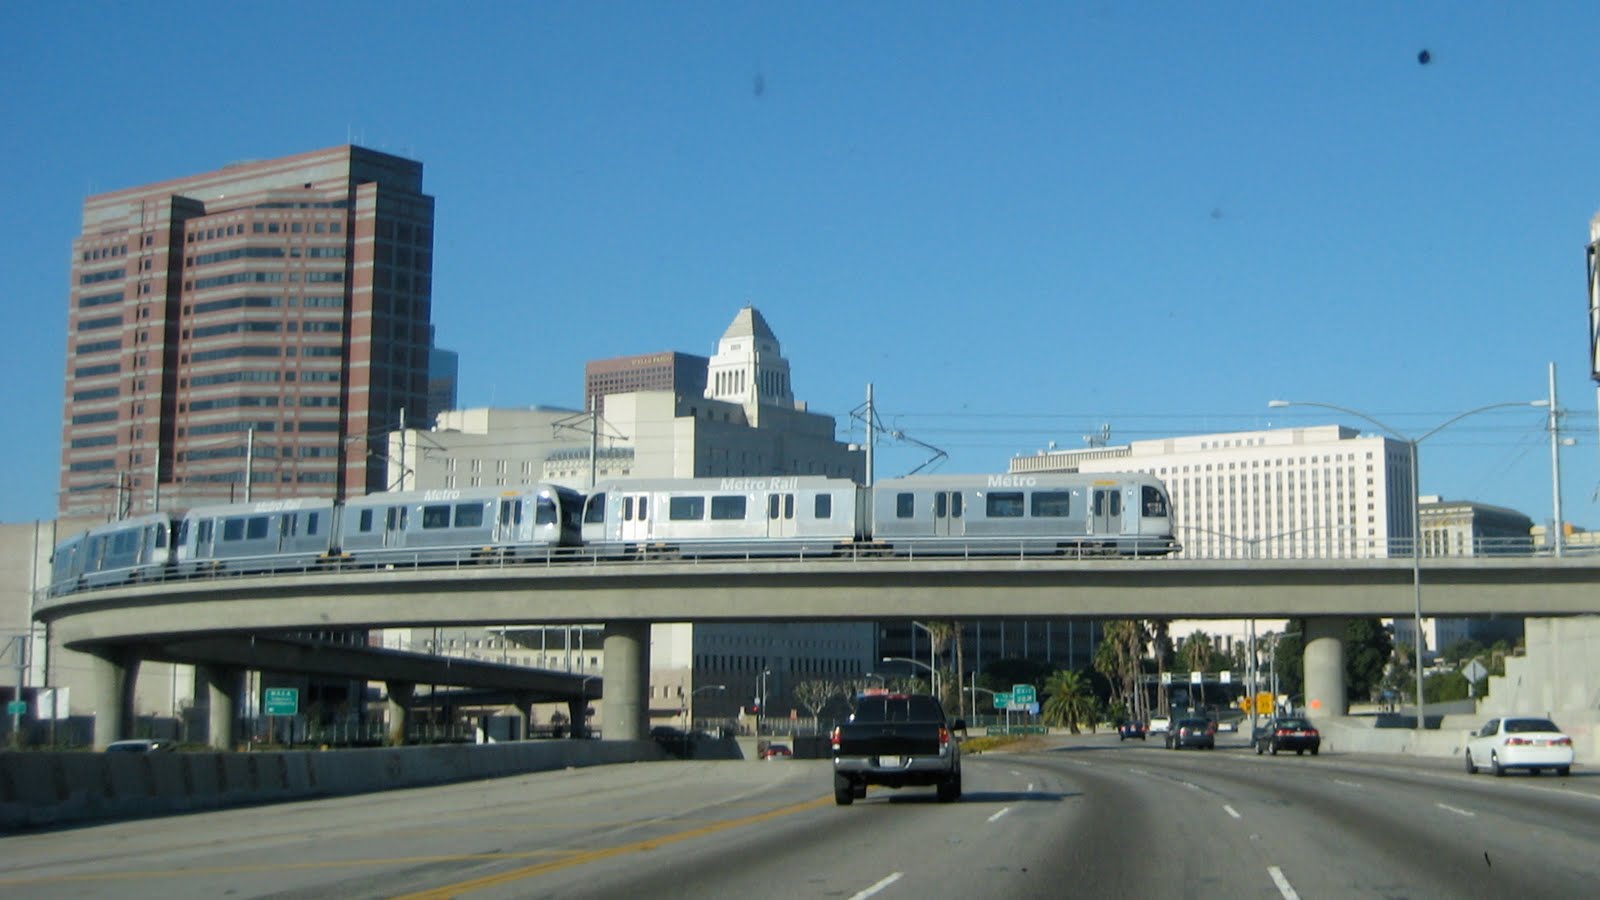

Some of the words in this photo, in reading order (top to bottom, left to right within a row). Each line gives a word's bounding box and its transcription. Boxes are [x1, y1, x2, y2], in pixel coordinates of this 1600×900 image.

[720, 478, 766, 491] Metro
[769, 477, 799, 490] Rail
[987, 474, 1037, 488] Metro
[423, 489, 461, 501] Metro
